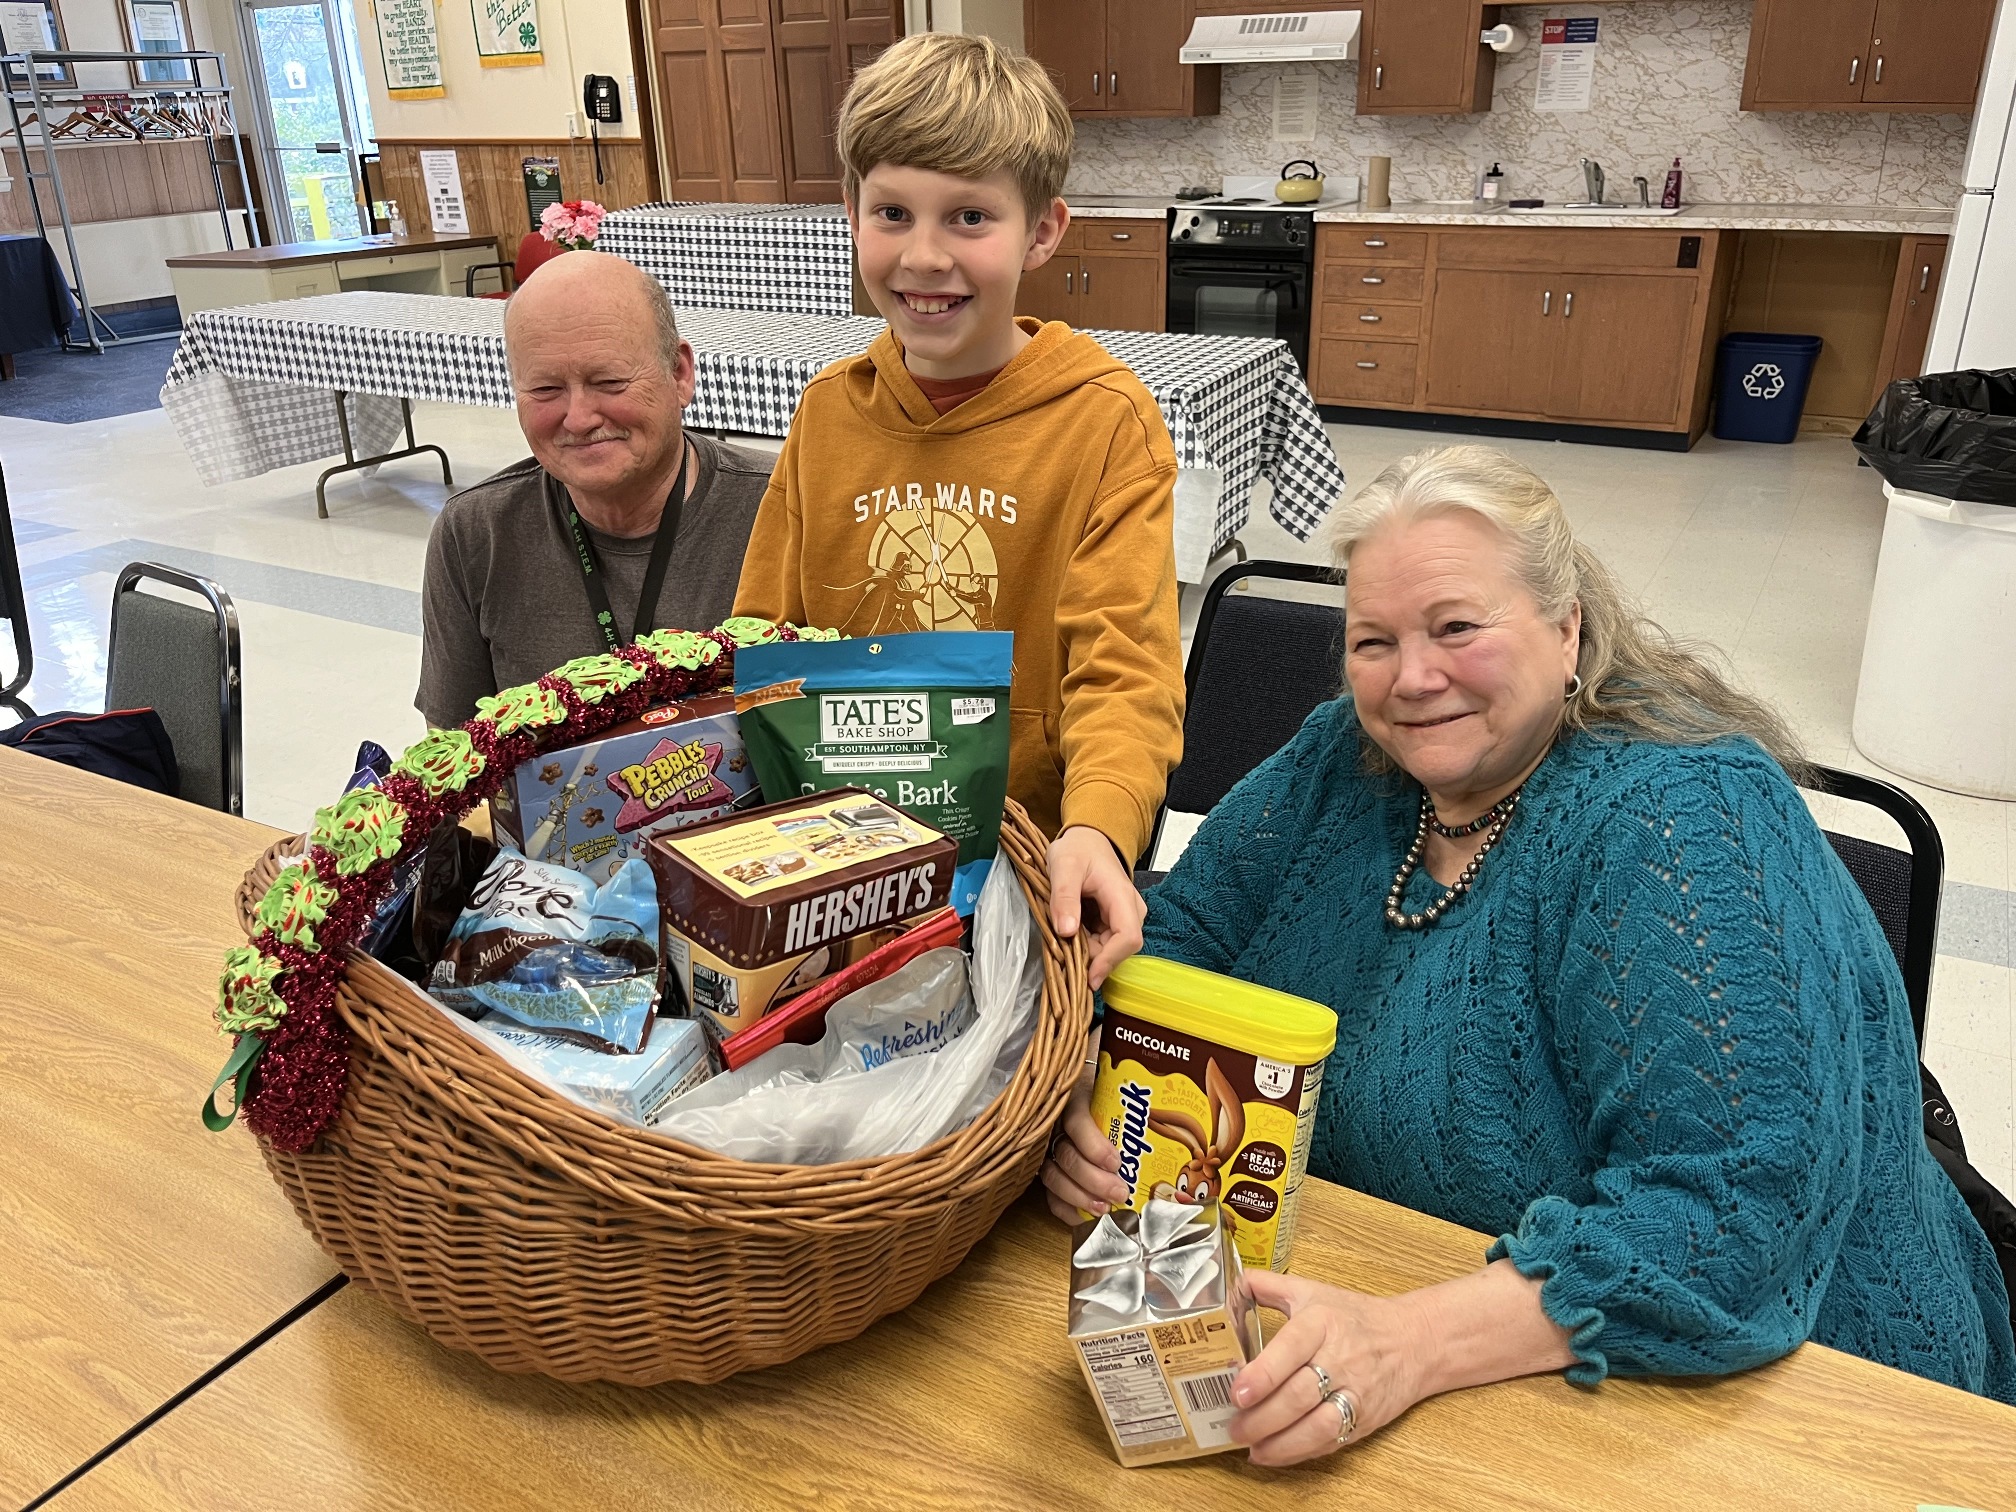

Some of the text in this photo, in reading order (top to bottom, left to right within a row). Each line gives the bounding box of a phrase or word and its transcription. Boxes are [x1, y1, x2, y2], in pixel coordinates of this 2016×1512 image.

[405, 17, 425, 27] HANDS
[1545, 26, 1564, 34] STOP
[409, 36, 430, 45] HEALTH
[854, 483, 1018, 525] STAR WARS
[573, 528, 582, 542] 4-H
[604, 627, 615, 641] 4-H
[755, 683, 796, 703] NEW
[647, 708, 674, 721] Post
[825, 699, 924, 726] TATE'S
[837, 727, 914, 739] BAKE SHOP
[839, 744, 911, 754] SOUTHAMPTON,
[913, 743, 926, 752] NY
[620, 740, 706, 798] PEBBLES
[857, 760, 875, 768] CRISPY
[897, 759, 922, 767] DELICIOUS
[684, 779, 715, 802] Tour!
[896, 779, 958, 806] Bark
[570, 842, 590, 854] Which
[784, 862, 936, 954] HERSHEY'S
[479, 946, 505, 967] Milk
[1115, 1027, 1190, 1061] CHOCOLATE
[1141, 1049, 1160, 1060] FLAVOR
[1260, 1062, 1291, 1073] AMERICA'S
[1268, 1072, 1278, 1085] #1
[1176, 1088, 1199, 1100] TASTY
[1161, 1096, 1207, 1118] CHOCOLATE
[1118, 1082, 1153, 1206] esquik
[1249, 1152, 1277, 1168] REAL
[1248, 1163, 1275, 1176] COCOA
[1231, 1192, 1274, 1209] ARTIFICIALS
[1247, 1191, 1260, 1199] no
[1080, 1335, 1119, 1348] Nutrition
[1120, 1331, 1146, 1341] Facts
[1091, 1362, 1123, 1373] Calories
[1134, 1354, 1154, 1366] 160
